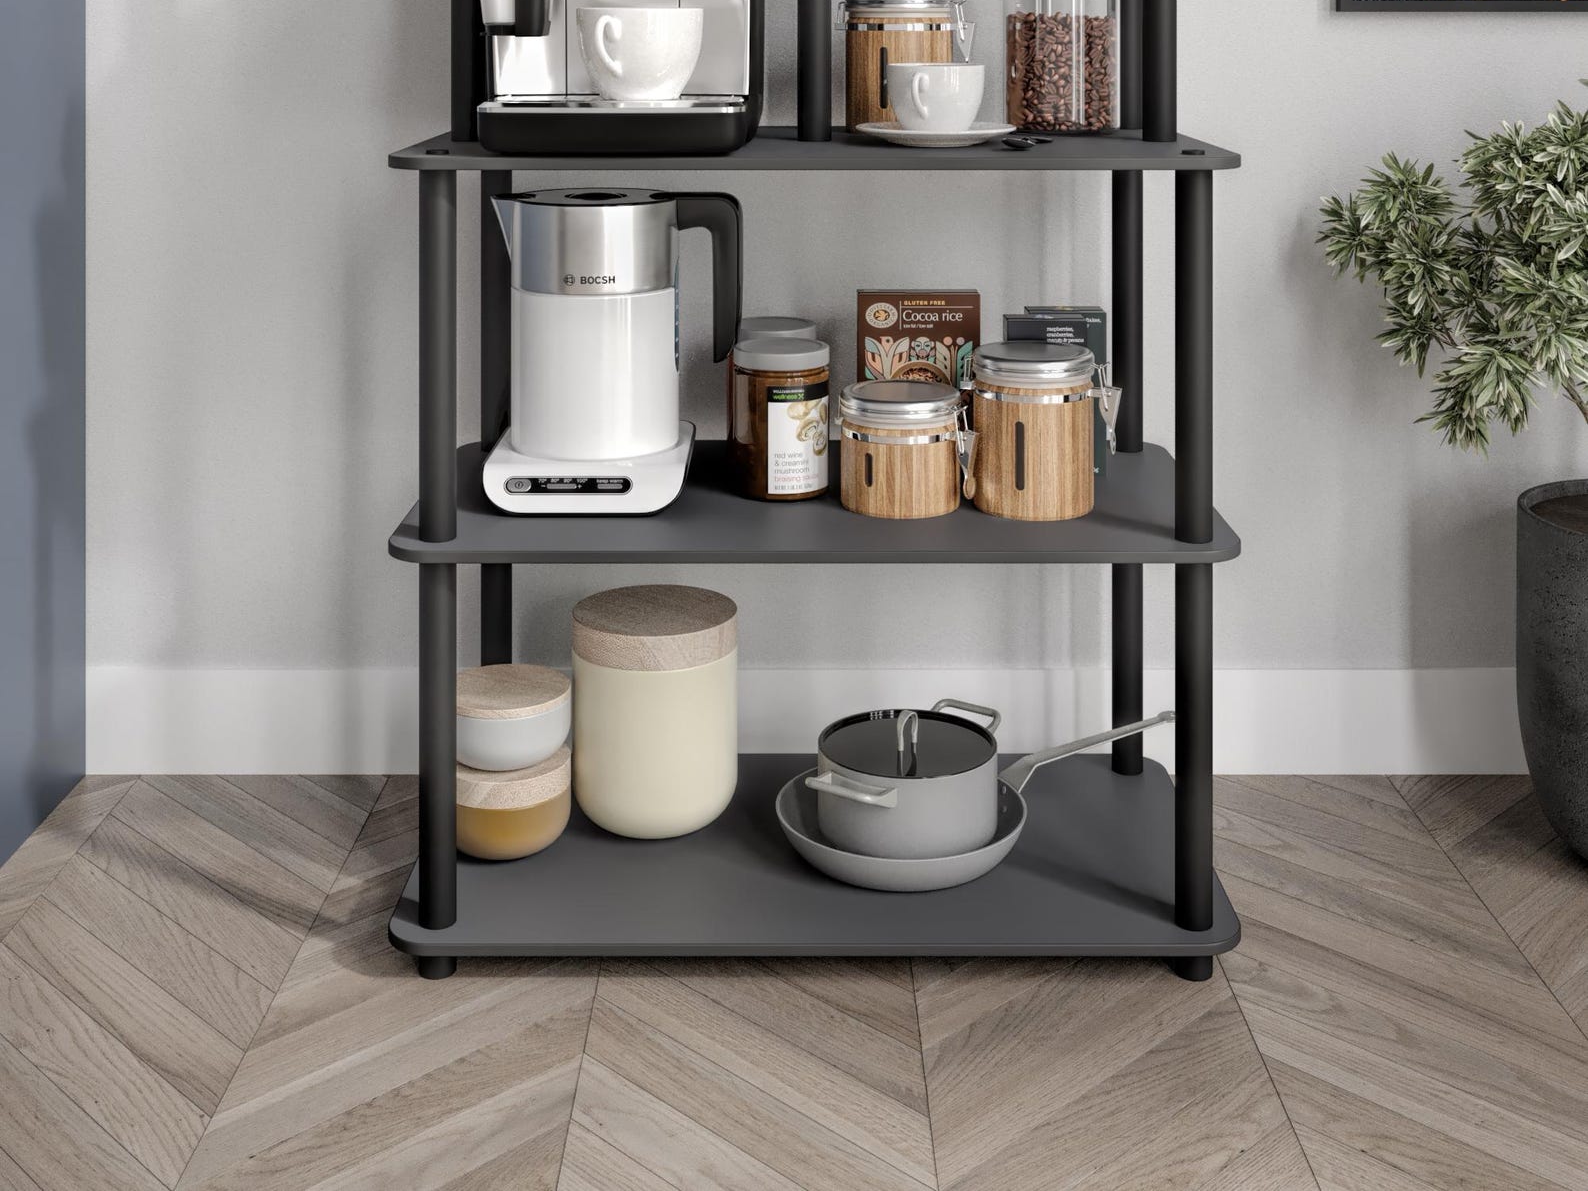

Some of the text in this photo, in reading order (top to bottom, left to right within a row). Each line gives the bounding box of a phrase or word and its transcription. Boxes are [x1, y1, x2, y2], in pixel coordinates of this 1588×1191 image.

[580, 275, 616, 285] BOCSH
[902, 310, 963, 322] Cocoa rice
